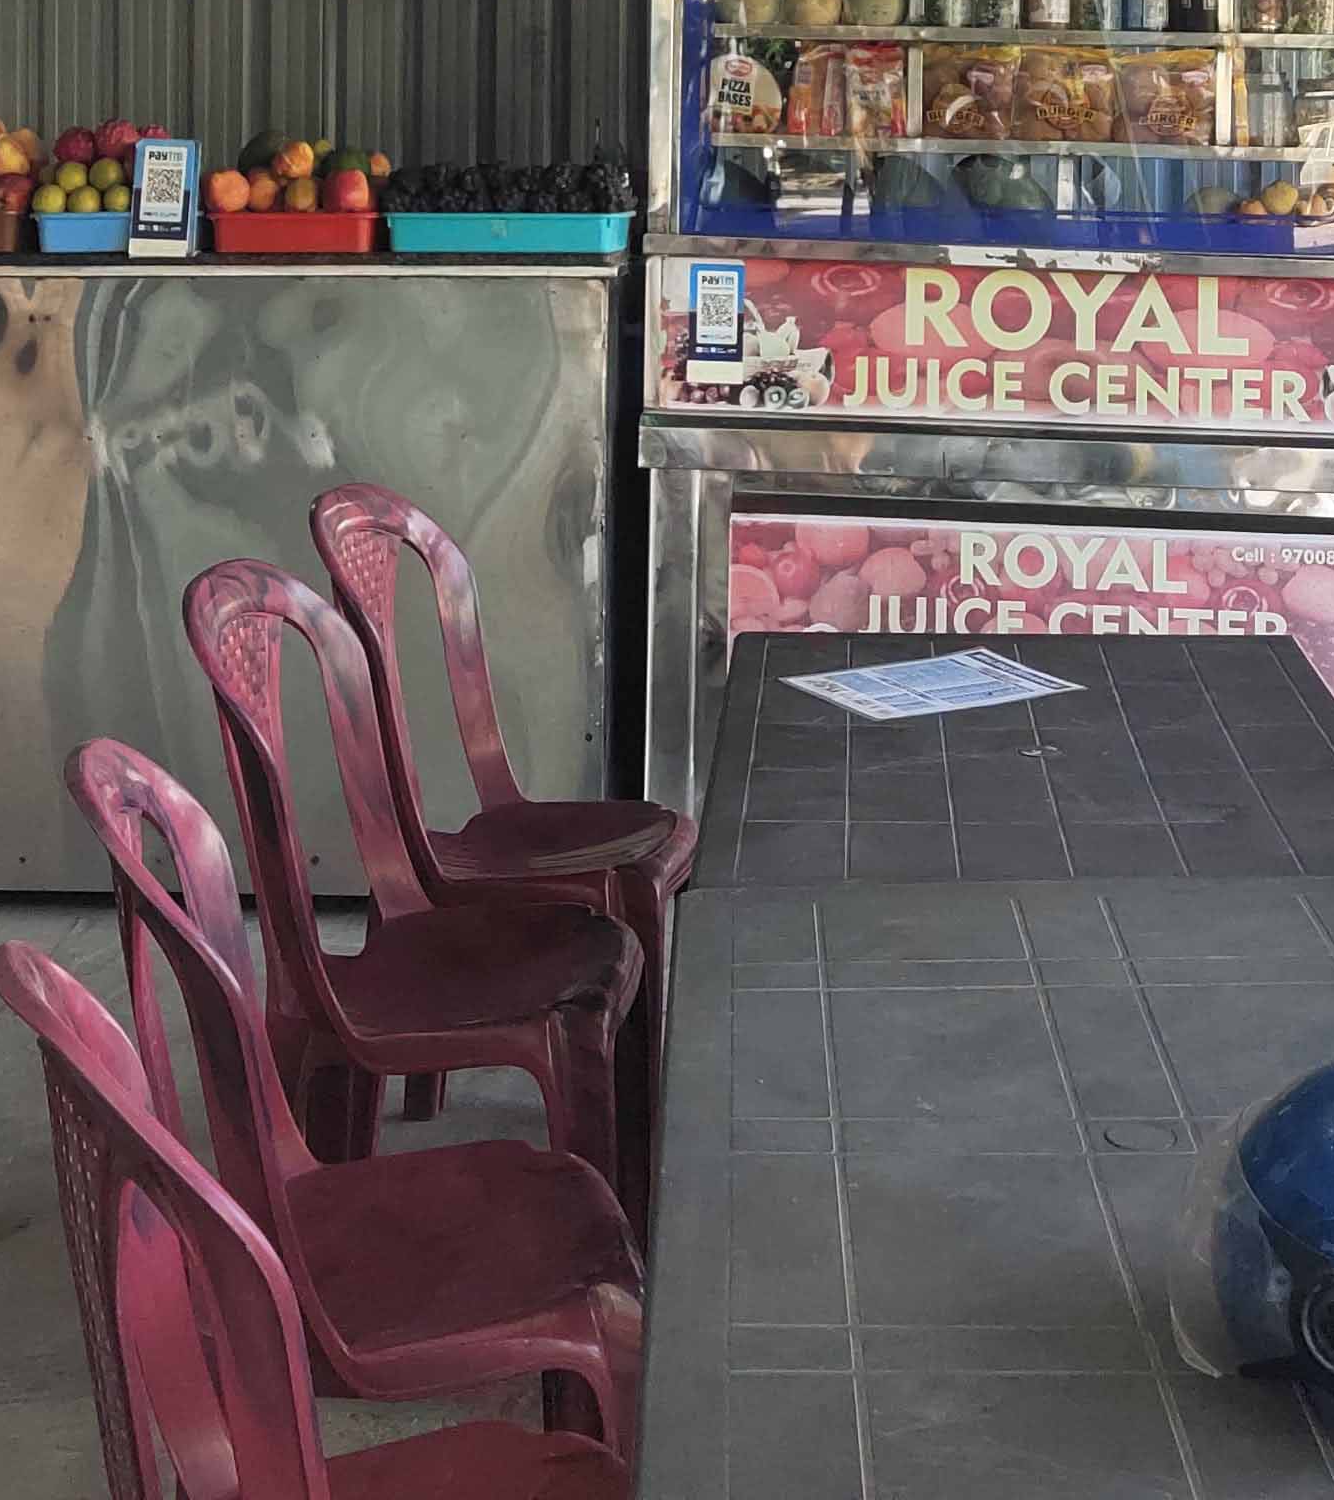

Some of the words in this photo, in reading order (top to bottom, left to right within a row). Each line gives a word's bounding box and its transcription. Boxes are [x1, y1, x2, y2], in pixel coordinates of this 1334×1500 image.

[717, 90, 752, 107] BASES
[720, 78, 751, 94] PIZZA
[903, 267, 1249, 356] ROYAL
[843, 356, 1026, 412] JUICE
[1049, 366, 1311, 423] CENTER
[959, 533, 1188, 594] ROYAL
[1232, 546, 1264, 563] Cell
[858, 594, 1027, 634] JUICE
